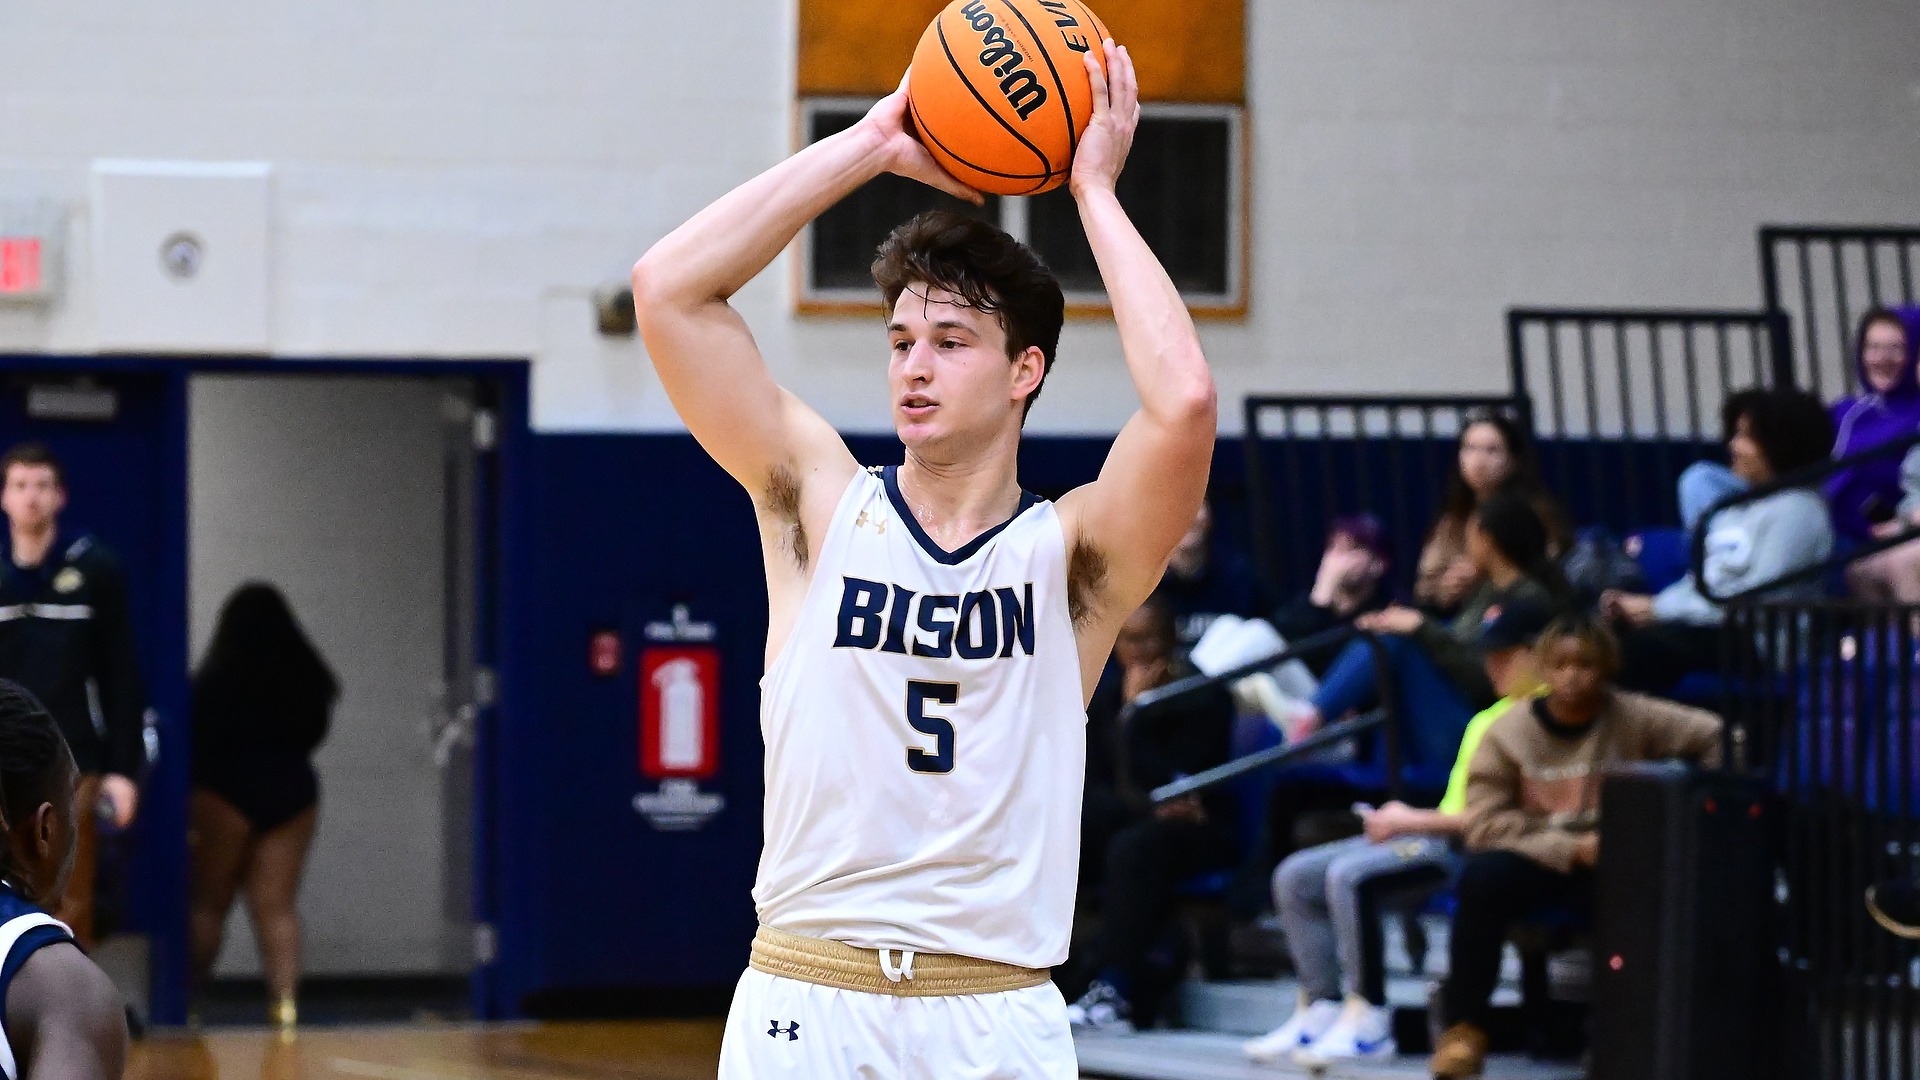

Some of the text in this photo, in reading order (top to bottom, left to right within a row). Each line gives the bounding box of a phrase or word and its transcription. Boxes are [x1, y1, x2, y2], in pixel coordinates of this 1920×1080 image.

[960, 0, 1047, 121] Wilson
[831, 574, 1036, 660] BISON
[905, 678, 960, 775] 5
